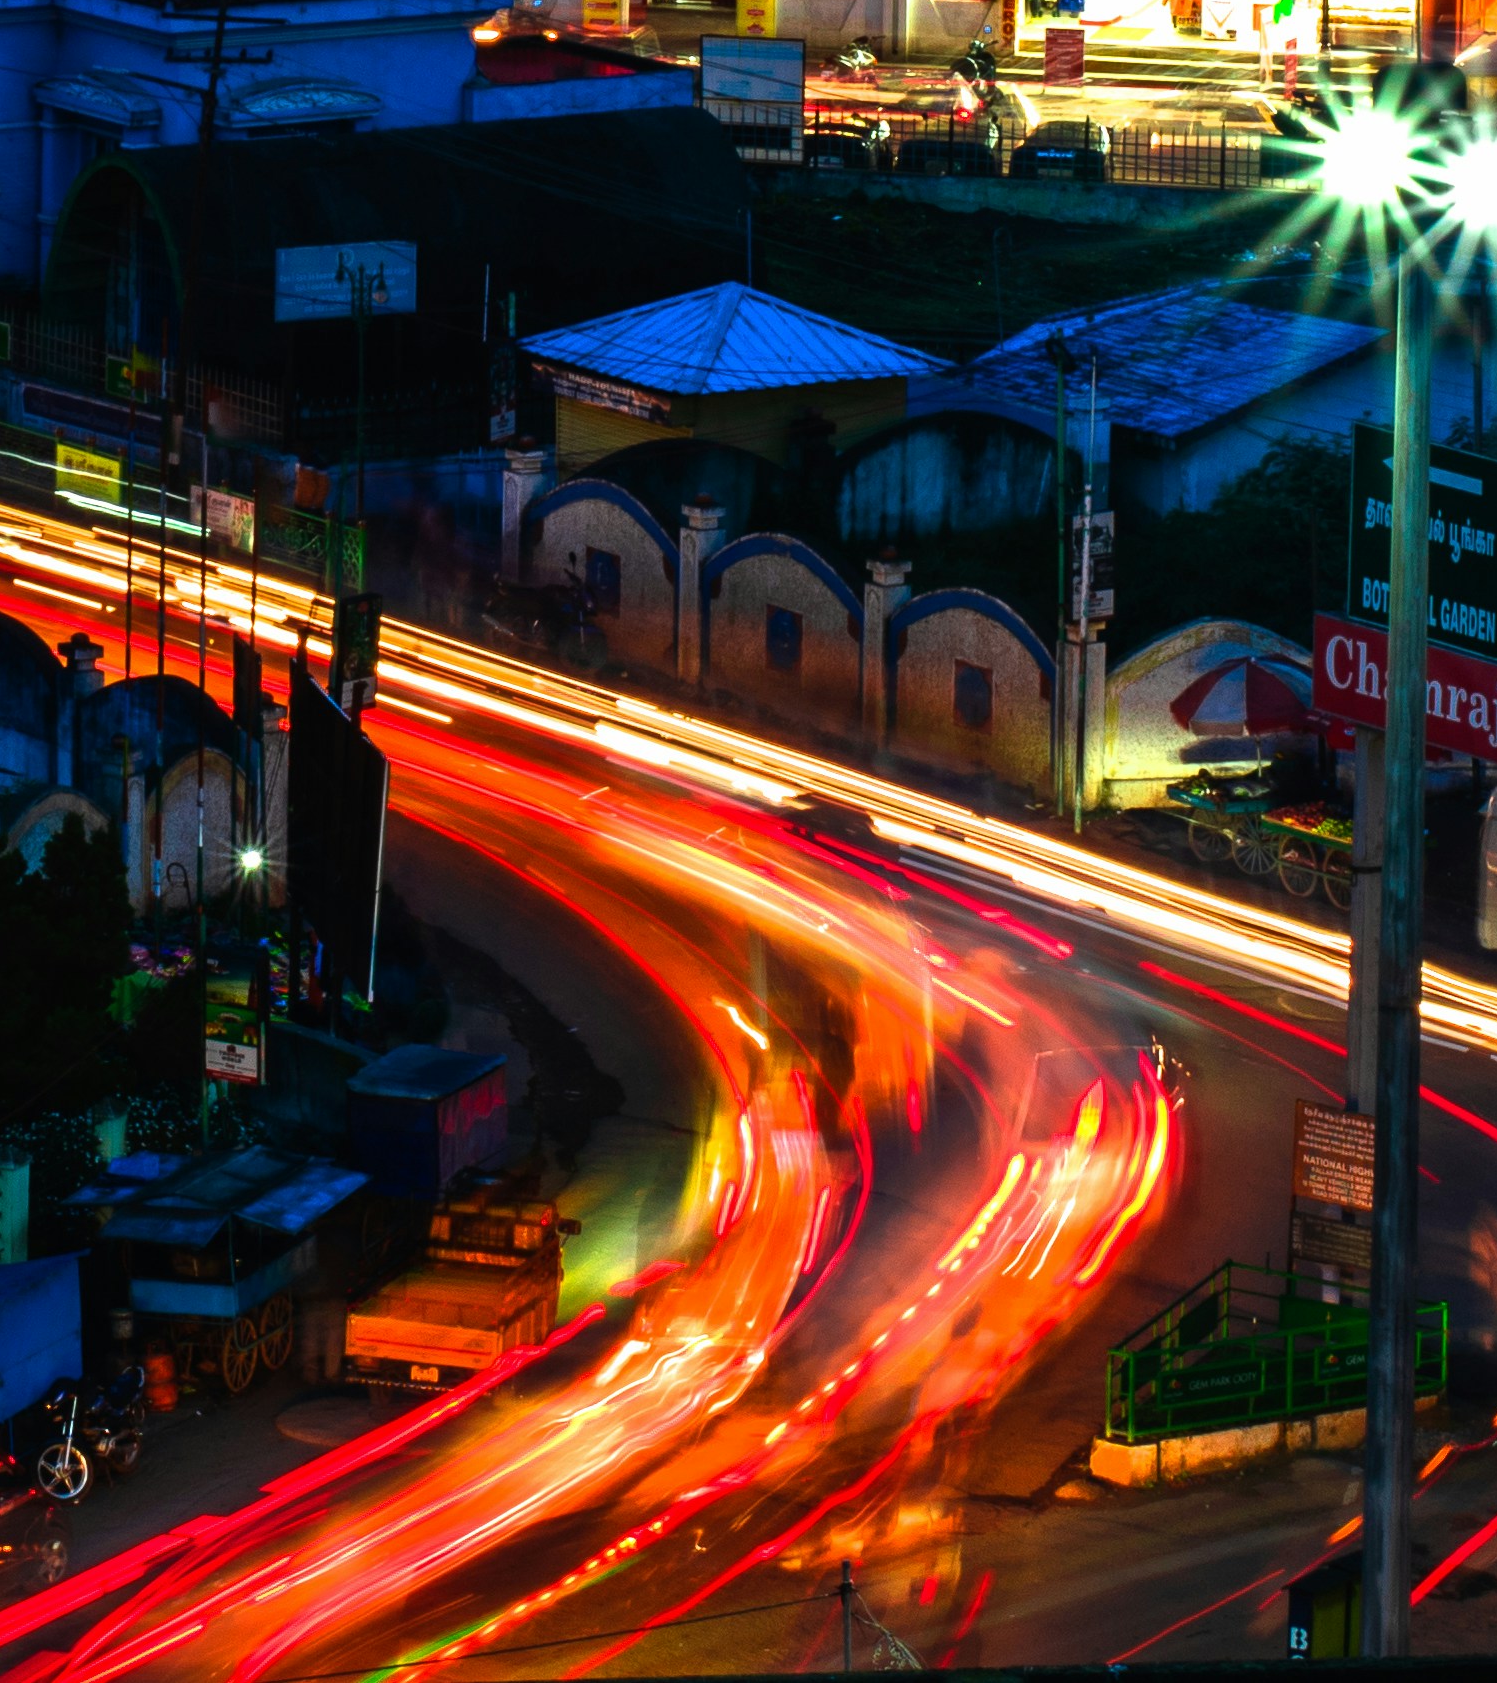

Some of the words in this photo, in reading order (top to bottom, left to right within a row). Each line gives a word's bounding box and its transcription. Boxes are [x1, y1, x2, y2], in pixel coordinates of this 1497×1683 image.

[1448, 517, 1496, 565] பூங்கா
[1440, 597, 1496, 645] GARDEN
[1303, 1153, 1346, 1173] NATIONAL
